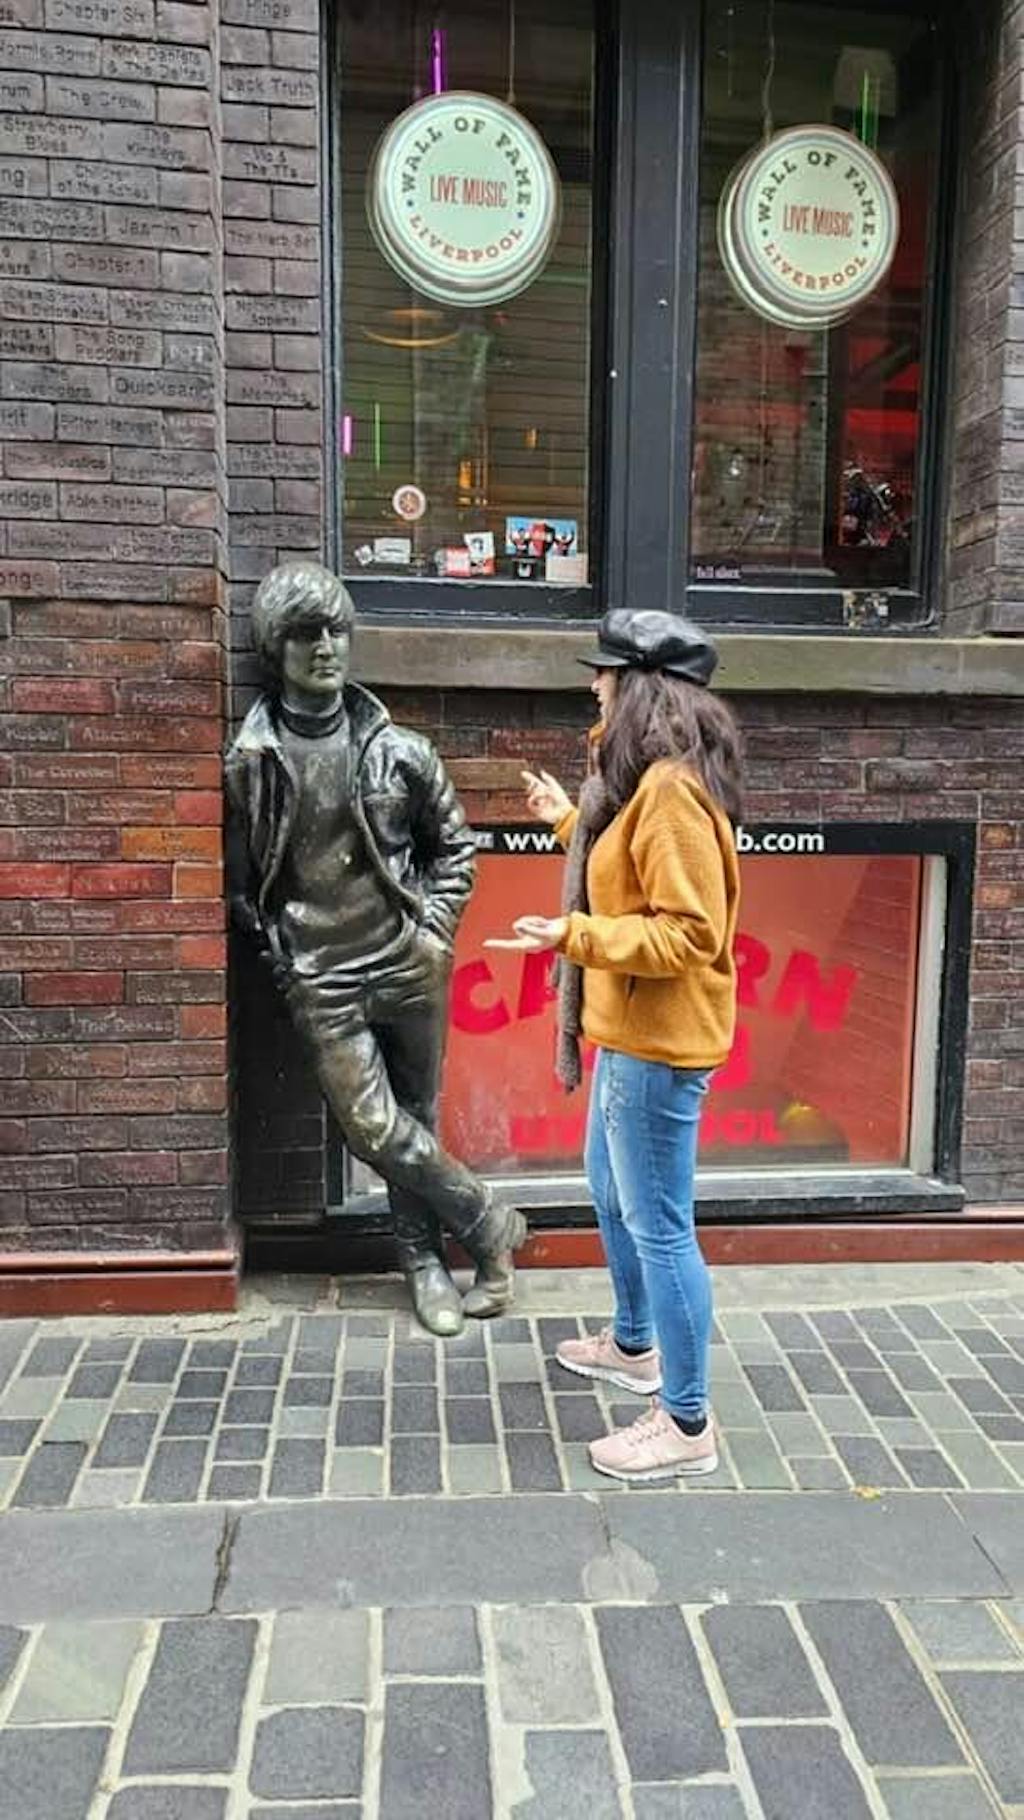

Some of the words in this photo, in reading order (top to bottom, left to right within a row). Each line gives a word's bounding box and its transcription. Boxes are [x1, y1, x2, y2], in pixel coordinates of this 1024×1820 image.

[402, 127, 443, 194] WALL
[454, 116, 486, 135] OF
[496, 132, 532, 206] FAME
[430, 175, 459, 206] LIVE
[462, 178, 508, 209] MUSIC
[758, 160, 798, 223] WALL
[807, 150, 838, 167] OF
[845, 166, 876, 236] FAME
[410, 214, 524, 263] LIVERPOOL
[783, 204, 812, 234] LIVE
[813, 206, 854, 238] MUSIC
[764, 243, 867, 291] LIVERPOOL
[451, 933, 858, 1034] CARN
